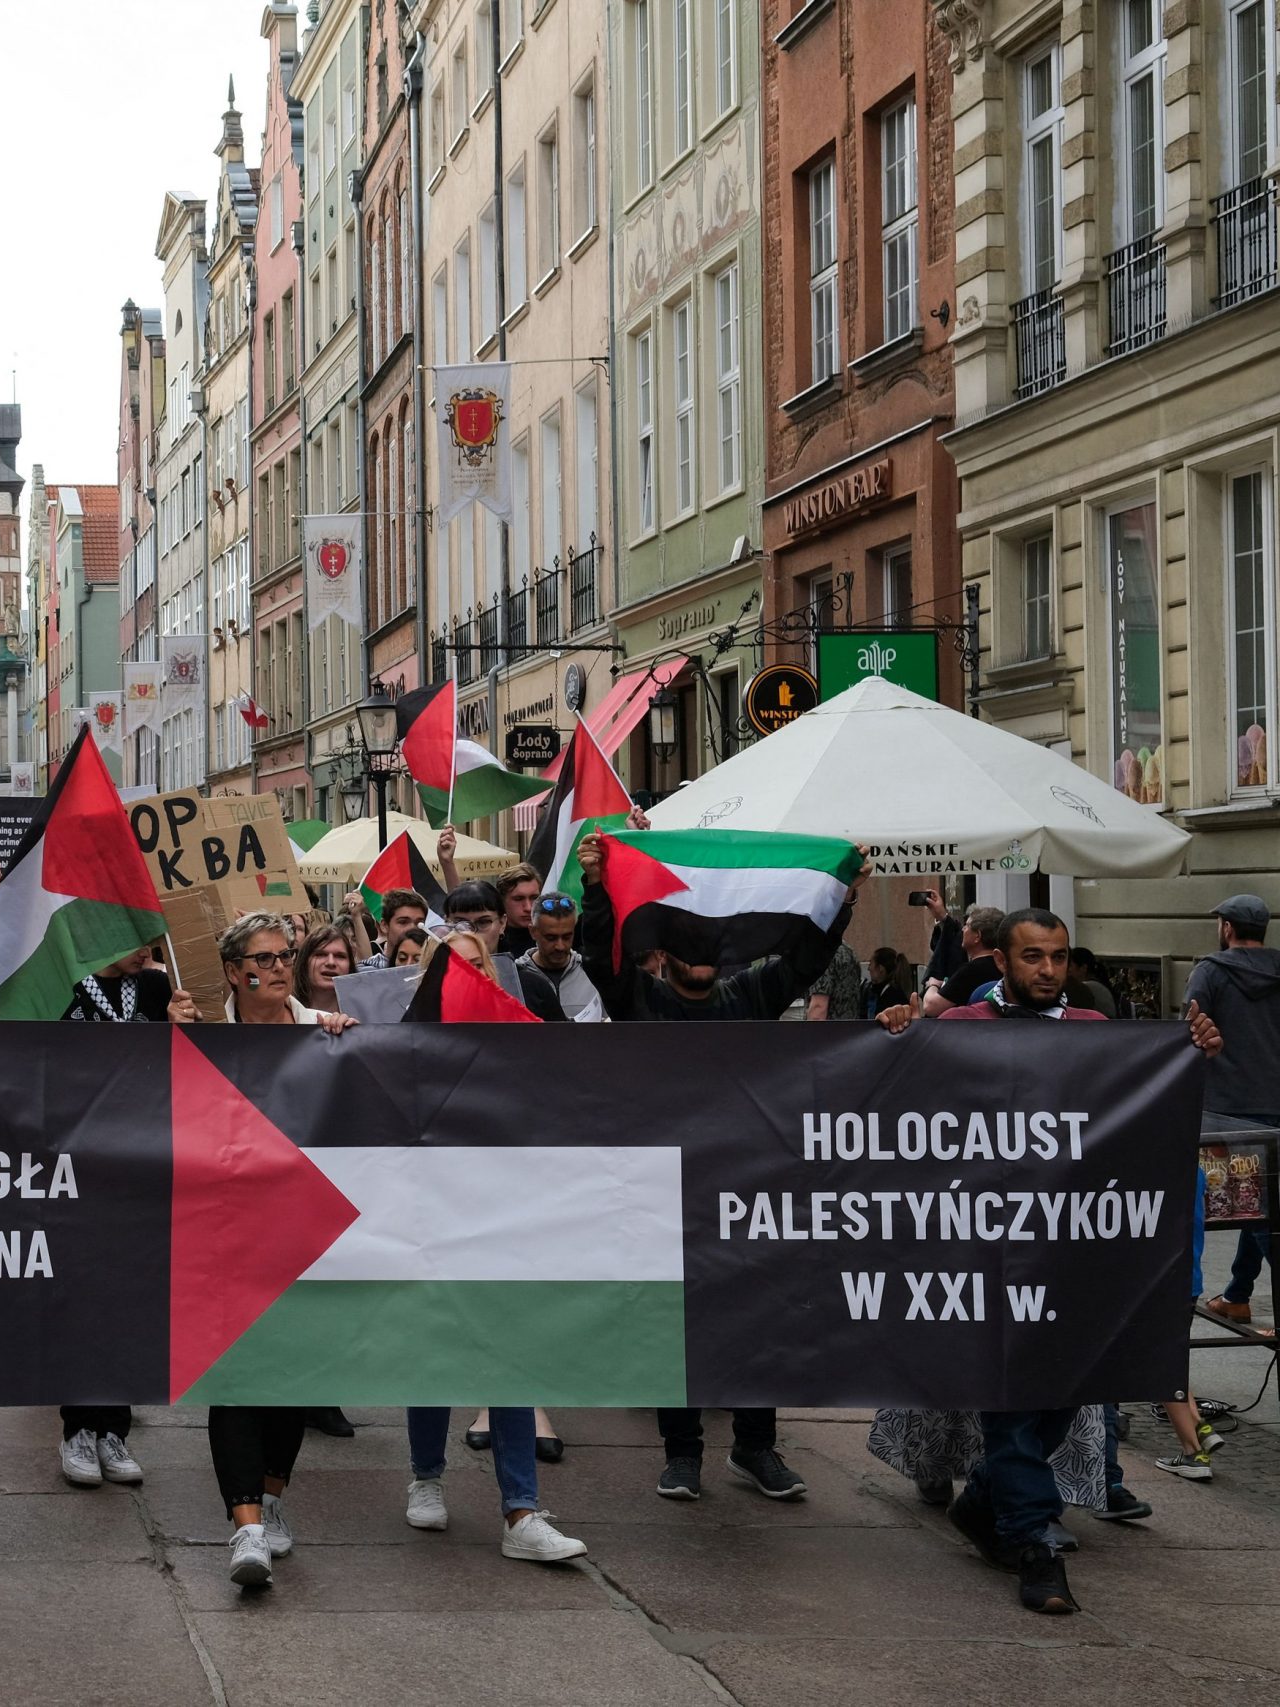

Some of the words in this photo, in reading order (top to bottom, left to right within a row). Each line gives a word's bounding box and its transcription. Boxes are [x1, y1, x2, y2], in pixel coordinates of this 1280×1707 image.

[783, 480, 845, 534] WINSTON
[850, 464, 881, 505] BAR
[657, 605, 715, 640] Soprano
[1119, 618, 1127, 744] NATURALNE
[760, 710, 805, 719] WINSTO
[774, 720, 793, 729] BA
[517, 733, 551, 749] Lody
[512, 748, 553, 760] Soprano
[16, 816, 32, 824] ever
[125, 797, 198, 853] OP
[157, 823, 267, 890] KBA
[870, 841, 959, 857] DAŃSKIE
[299, 866, 339, 876] RYCAN
[468, 860, 512, 872] GRYCAN
[875, 858, 996, 875] NATURALNE
[803, 1111, 1089, 1161] HOLOCAUST
[719, 1178, 1165, 1241] PALESTYŃCZYKÓW
[841, 1271, 886, 1320] W
[903, 1272, 986, 1321] XXI
[1006, 1285, 1056, 1322] w.
